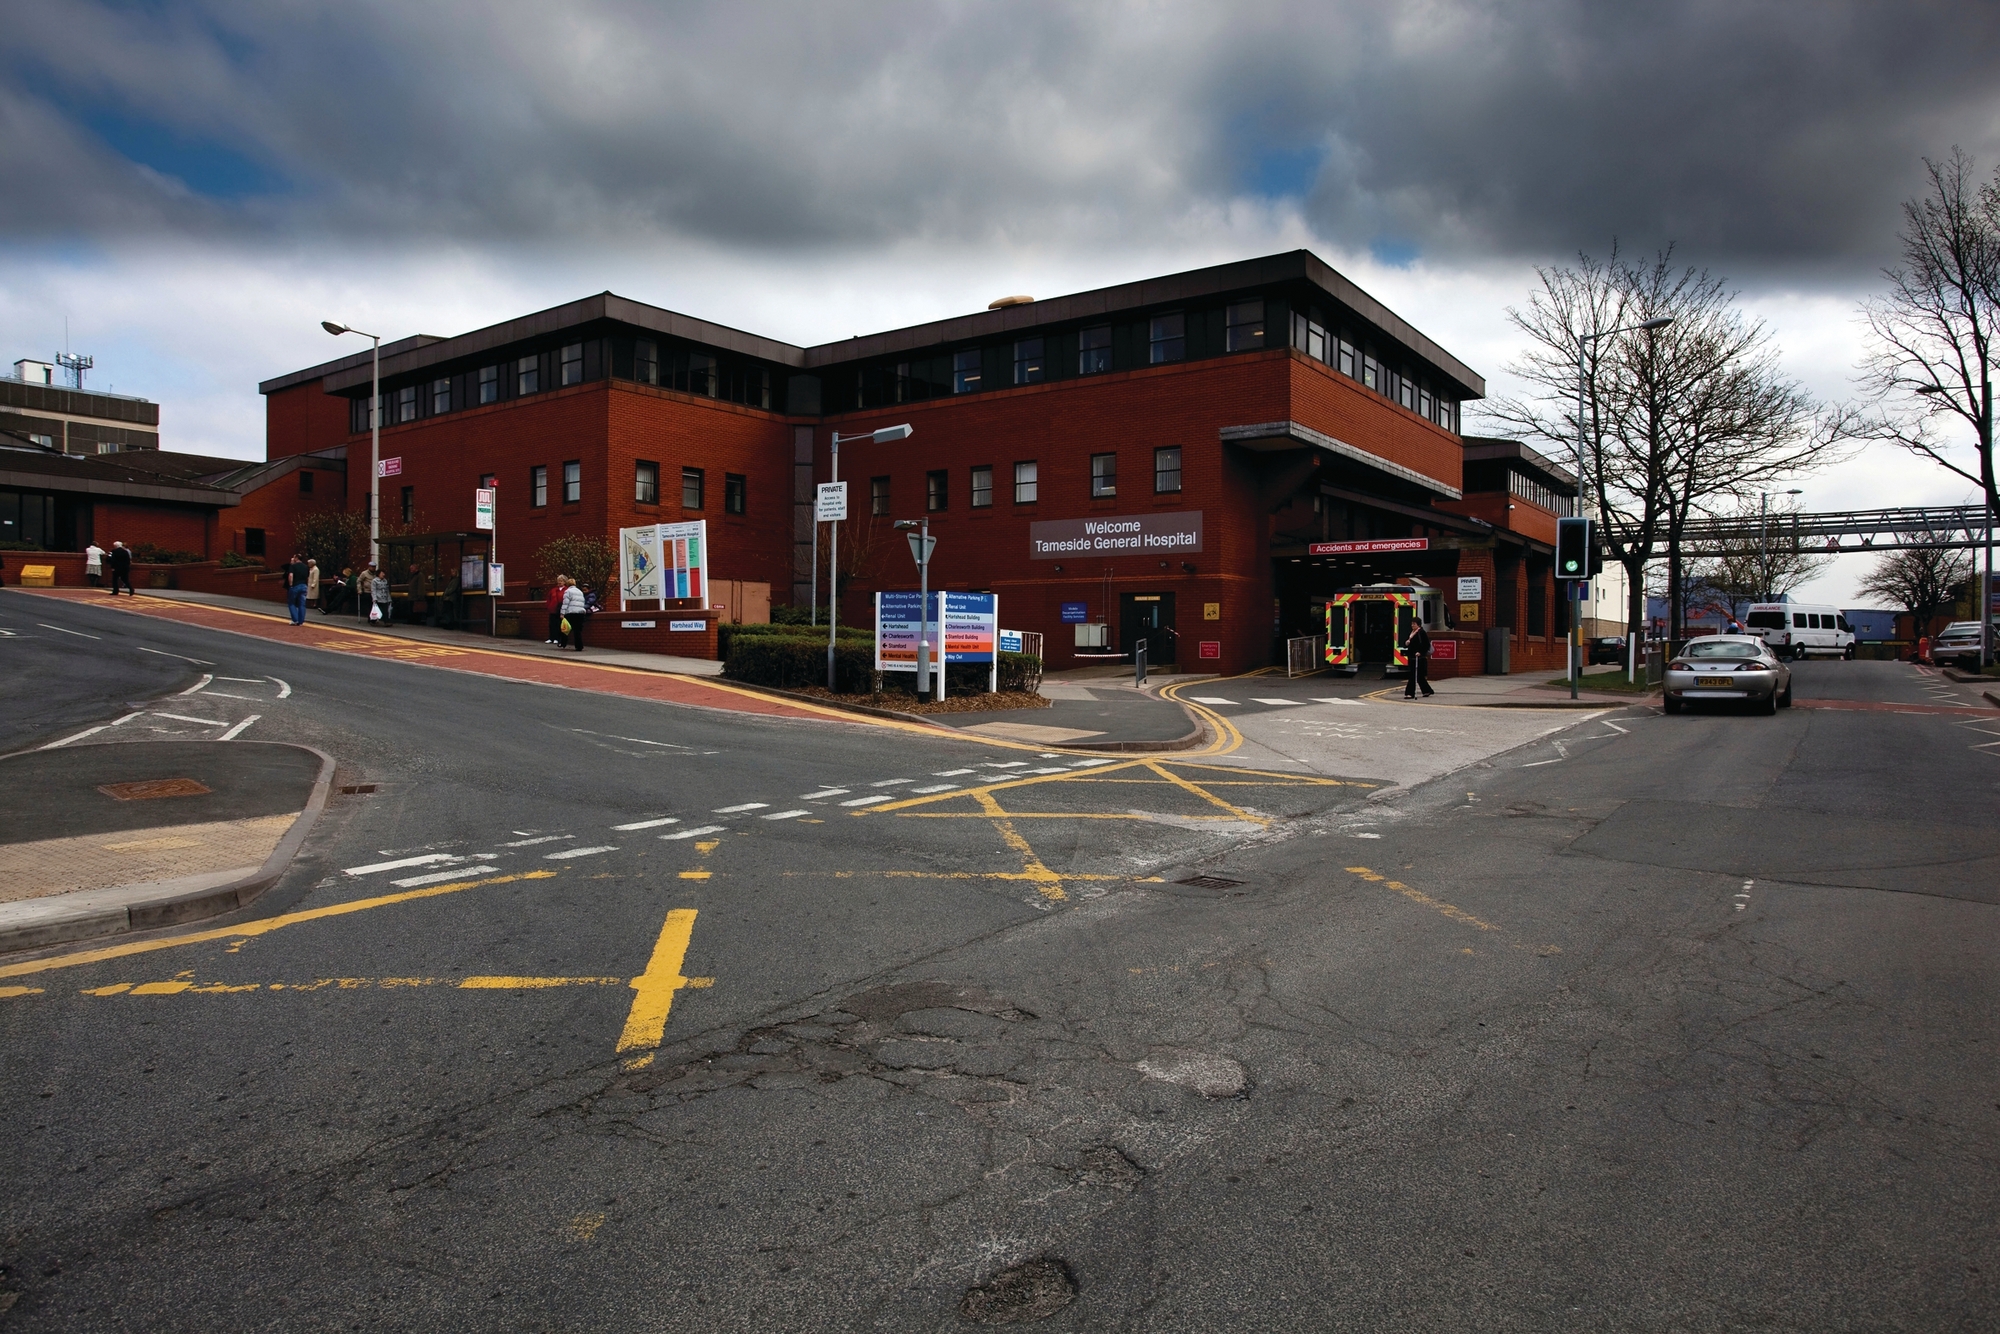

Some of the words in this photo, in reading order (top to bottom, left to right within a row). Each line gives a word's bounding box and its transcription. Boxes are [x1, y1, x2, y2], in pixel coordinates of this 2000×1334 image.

[821, 485, 843, 493] PRIVATE
[1085, 521, 1141, 535] Welcome
[1036, 538, 1091, 552] Tameside
[1094, 535, 1141, 549] General
[1144, 532, 1196, 548] Hospital
[1316, 544, 1352, 553] Accidents
[1355, 542, 1369, 551] and
[1372, 541, 1421, 551] emergencies
[694, 622, 705, 630] Way
